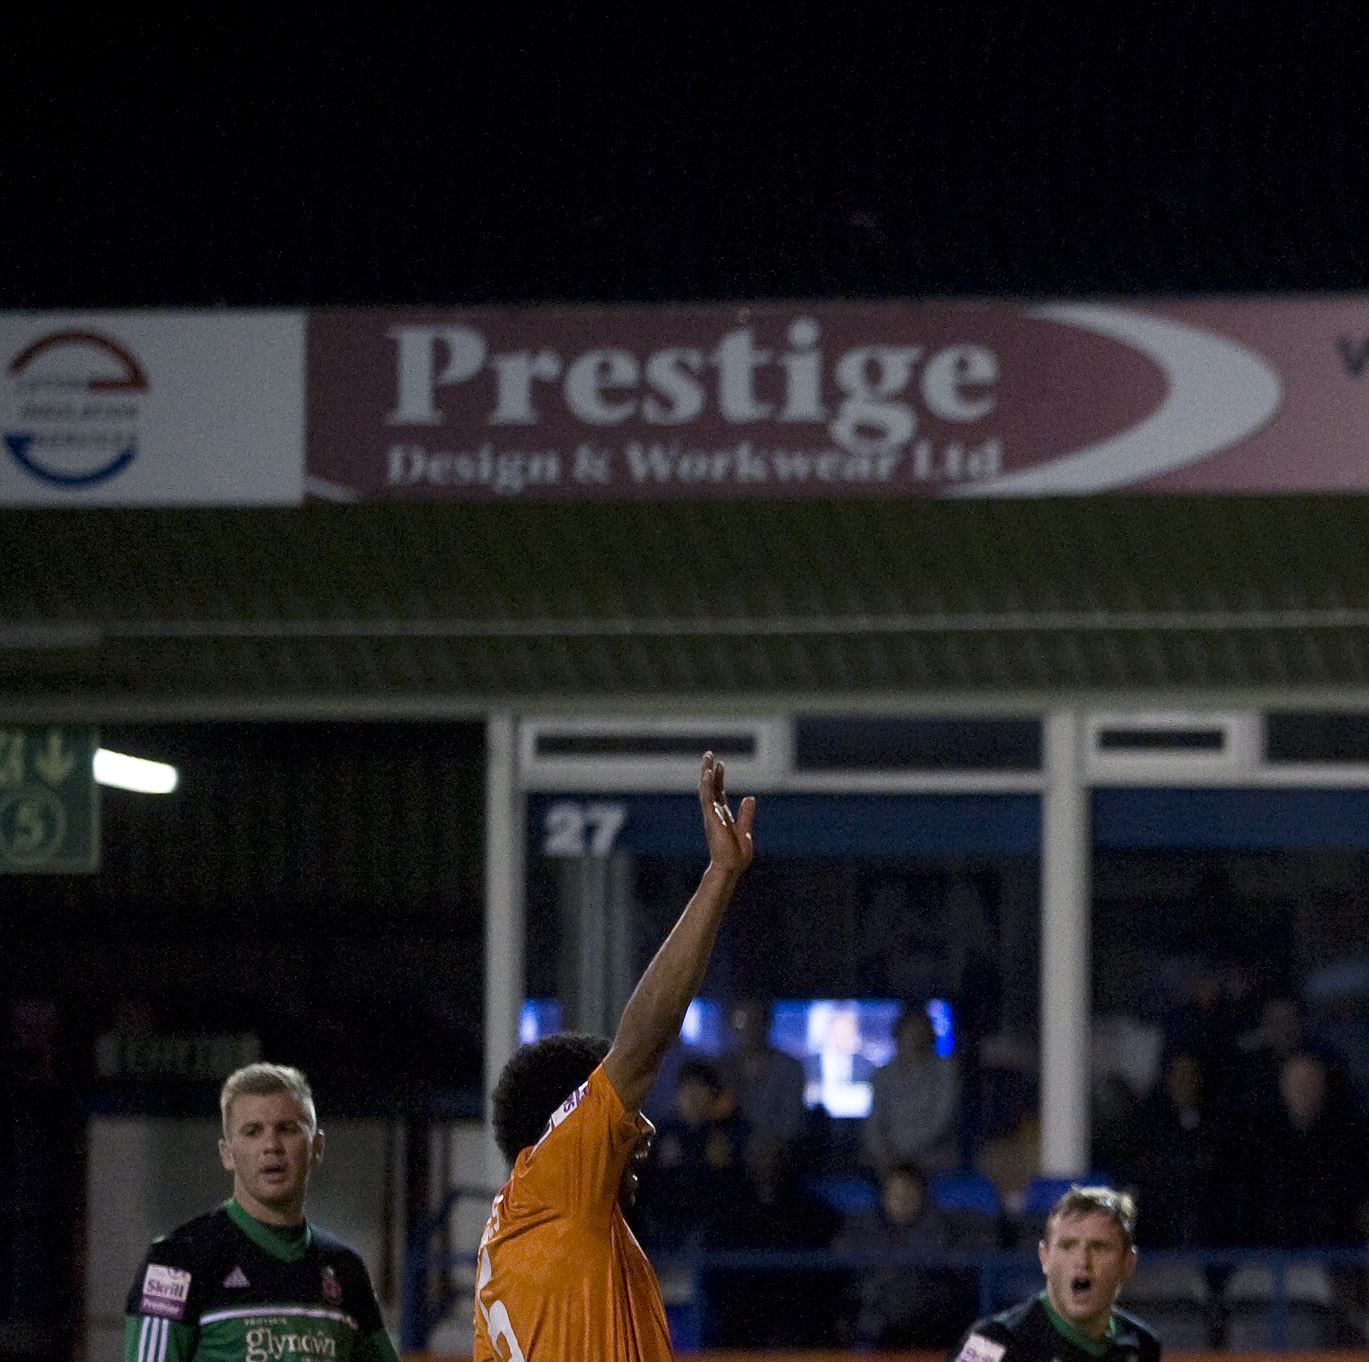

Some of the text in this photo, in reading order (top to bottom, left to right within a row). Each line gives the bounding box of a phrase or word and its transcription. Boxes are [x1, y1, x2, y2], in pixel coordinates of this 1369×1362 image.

[386, 317, 999, 454] Prestige
[388, 438, 1001, 496] Design & Workwear Ltd
[544, 800, 628, 857] 27
[146, 1277, 184, 1298] Skrill
